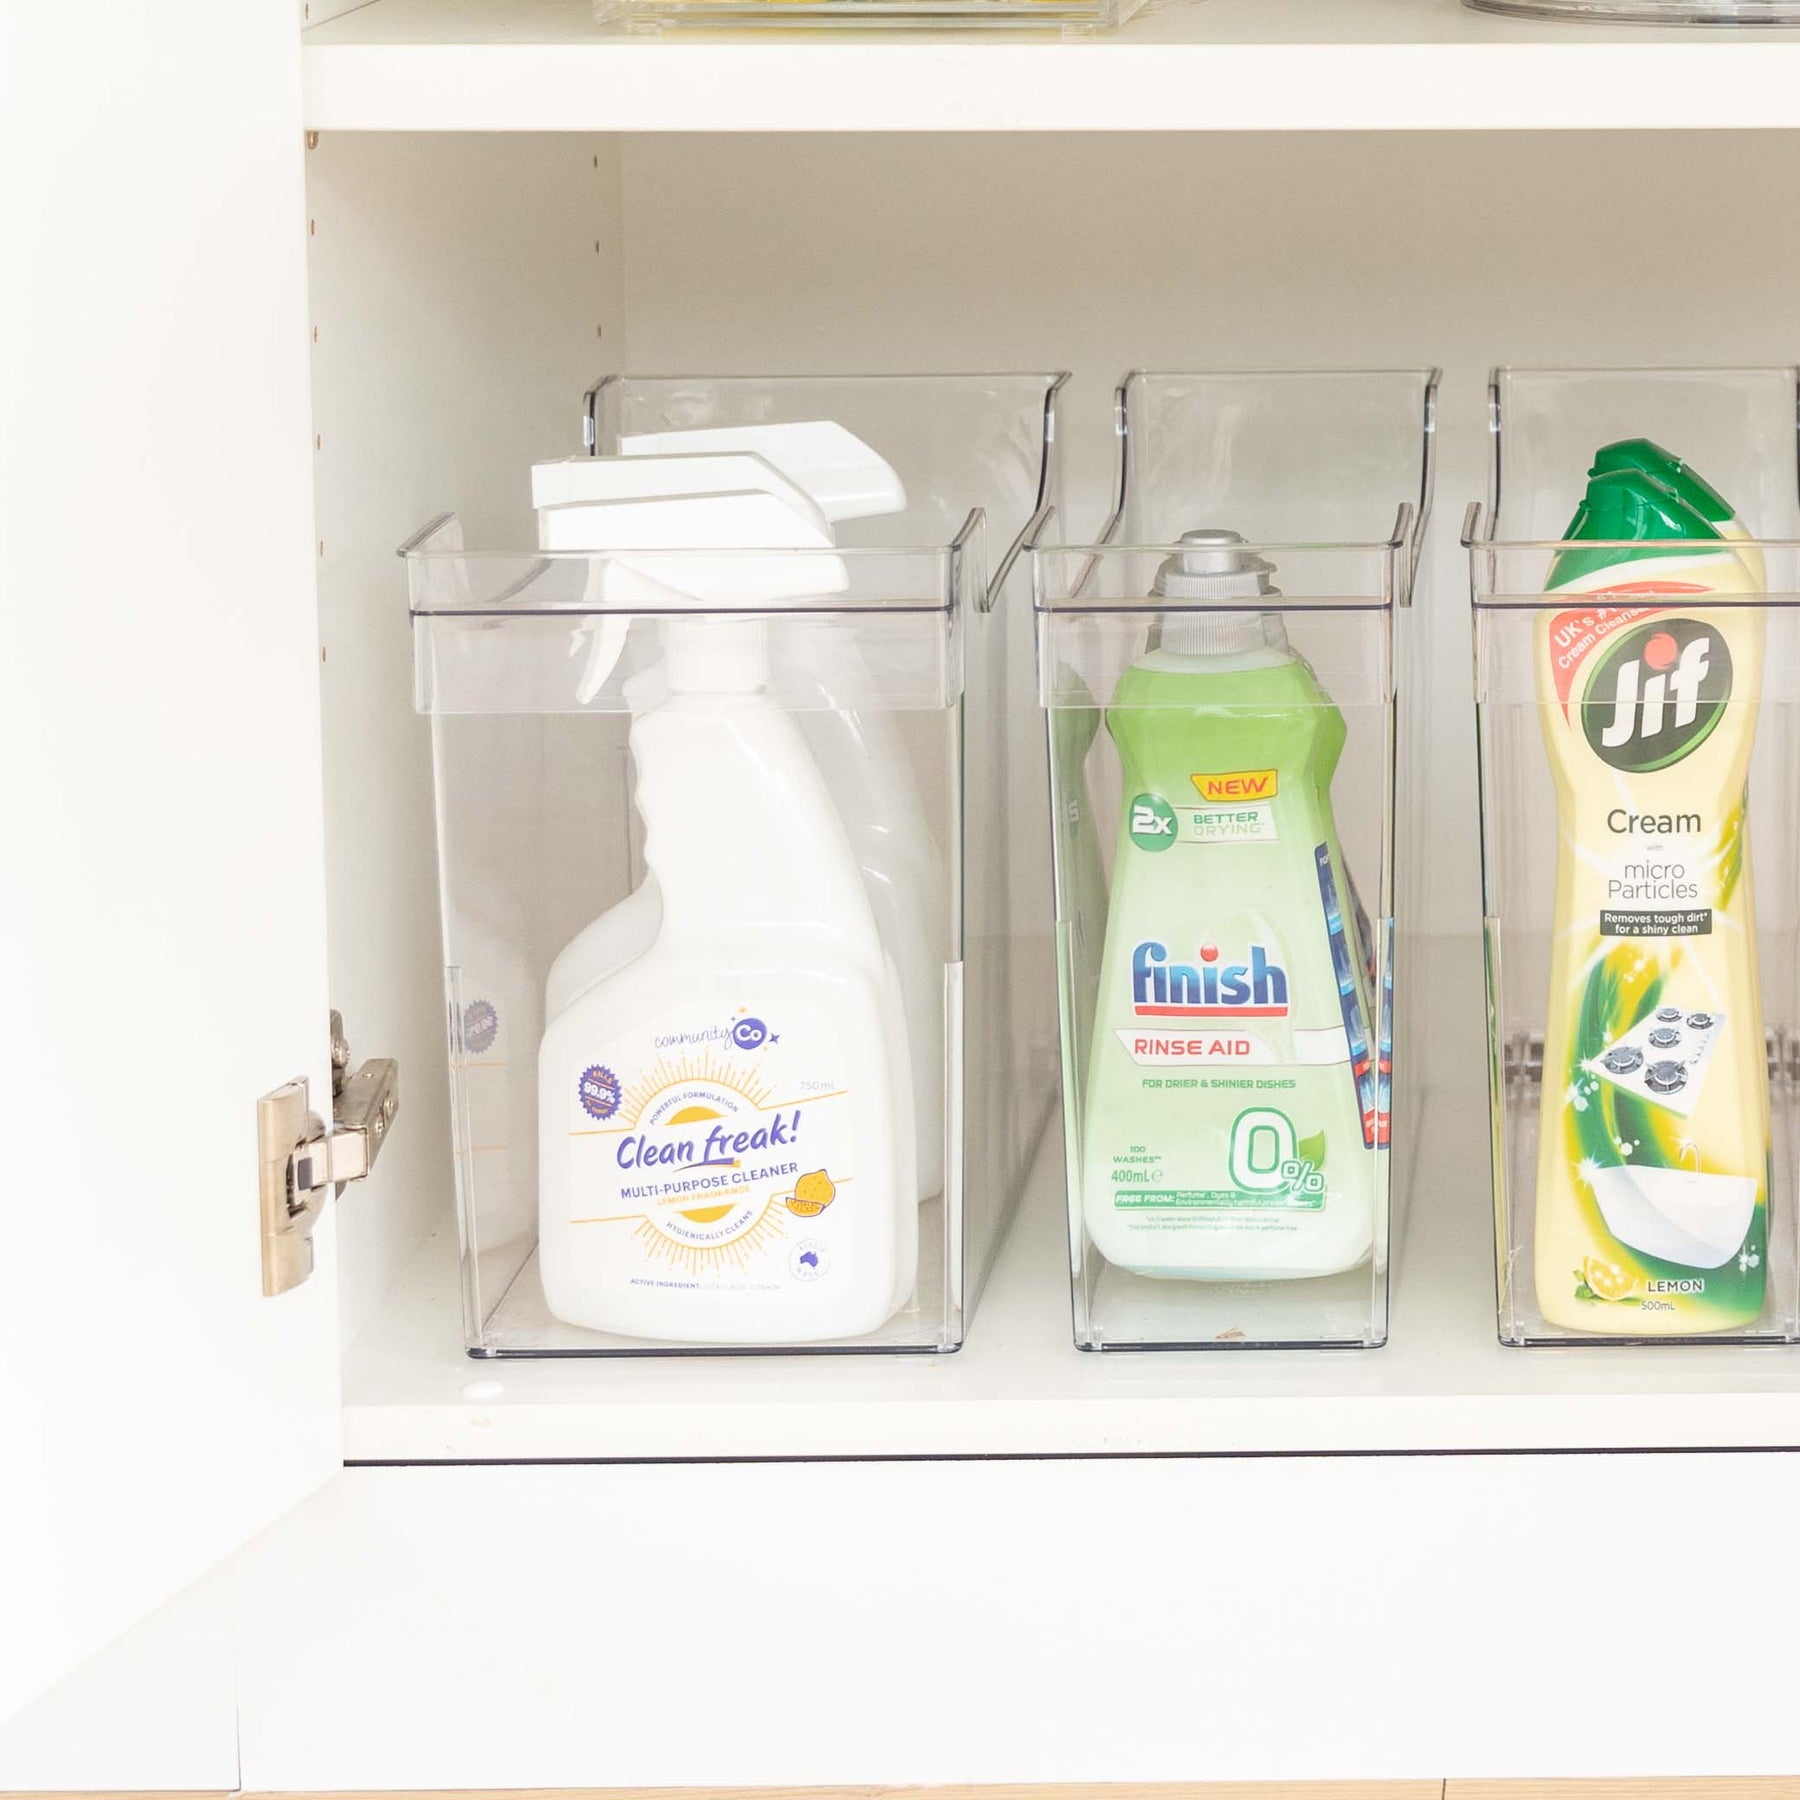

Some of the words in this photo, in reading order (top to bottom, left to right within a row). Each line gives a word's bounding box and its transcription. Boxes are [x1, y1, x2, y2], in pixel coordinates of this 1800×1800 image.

[1554, 616, 1595, 648] UK's
[1558, 633, 1596, 669] Cream
[1595, 608, 1650, 635] Cleanse
[1602, 632, 1710, 748] Jif
[1207, 775, 1269, 795] NEW
[1131, 804, 1173, 835] 2x
[1193, 811, 1258, 825] BETTER
[1607, 808, 1701, 834] Cream
[1193, 823, 1262, 836] DRYING
[1624, 860, 1685, 880] micro
[1608, 879, 1698, 899] Particles
[1604, 913, 1651, 923] Removes
[1654, 913, 1685, 925] tough
[1615, 924, 1630, 933] for
[1642, 923, 1669, 936] shiny
[1671, 924, 1698, 933] clean
[1132, 941, 1288, 1004] finish
[655, 1023, 735, 1050] community
[735, 1023, 763, 1042] Co
[1135, 1038, 1202, 1055] RINSE
[1208, 1039, 1250, 1055] AID
[584, 1082, 616, 1104] 99.9%
[1142, 1079, 1163, 1088] FOR
[1165, 1079, 1198, 1088] DRIER
[1200, 1080, 1208, 1088] &
[1211, 1080, 1253, 1088] SHINIER
[1256, 1080, 1296, 1089] DISHES
[650, 1095, 682, 1126] POWERFUL
[683, 1091, 738, 1113] FORMULATION
[616, 1134, 694, 1169] Clean
[702, 1110, 801, 1163] freak!
[1228, 1107, 1325, 1194] 0%
[620, 1175, 729, 1199] MULTI-PURPOSE
[731, 1162, 798, 1184] CLEANER
[1111, 1170, 1151, 1183] 400mL
[1115, 1194, 1142, 1204] FREE
[1143, 1194, 1175, 1204] FROM:
[666, 1220, 725, 1240] HYGIENICALLY
[725, 1210, 753, 1234] CLEANS
[1648, 1280, 1703, 1293] LEMON
[1641, 1301, 1675, 1311] 500mL
